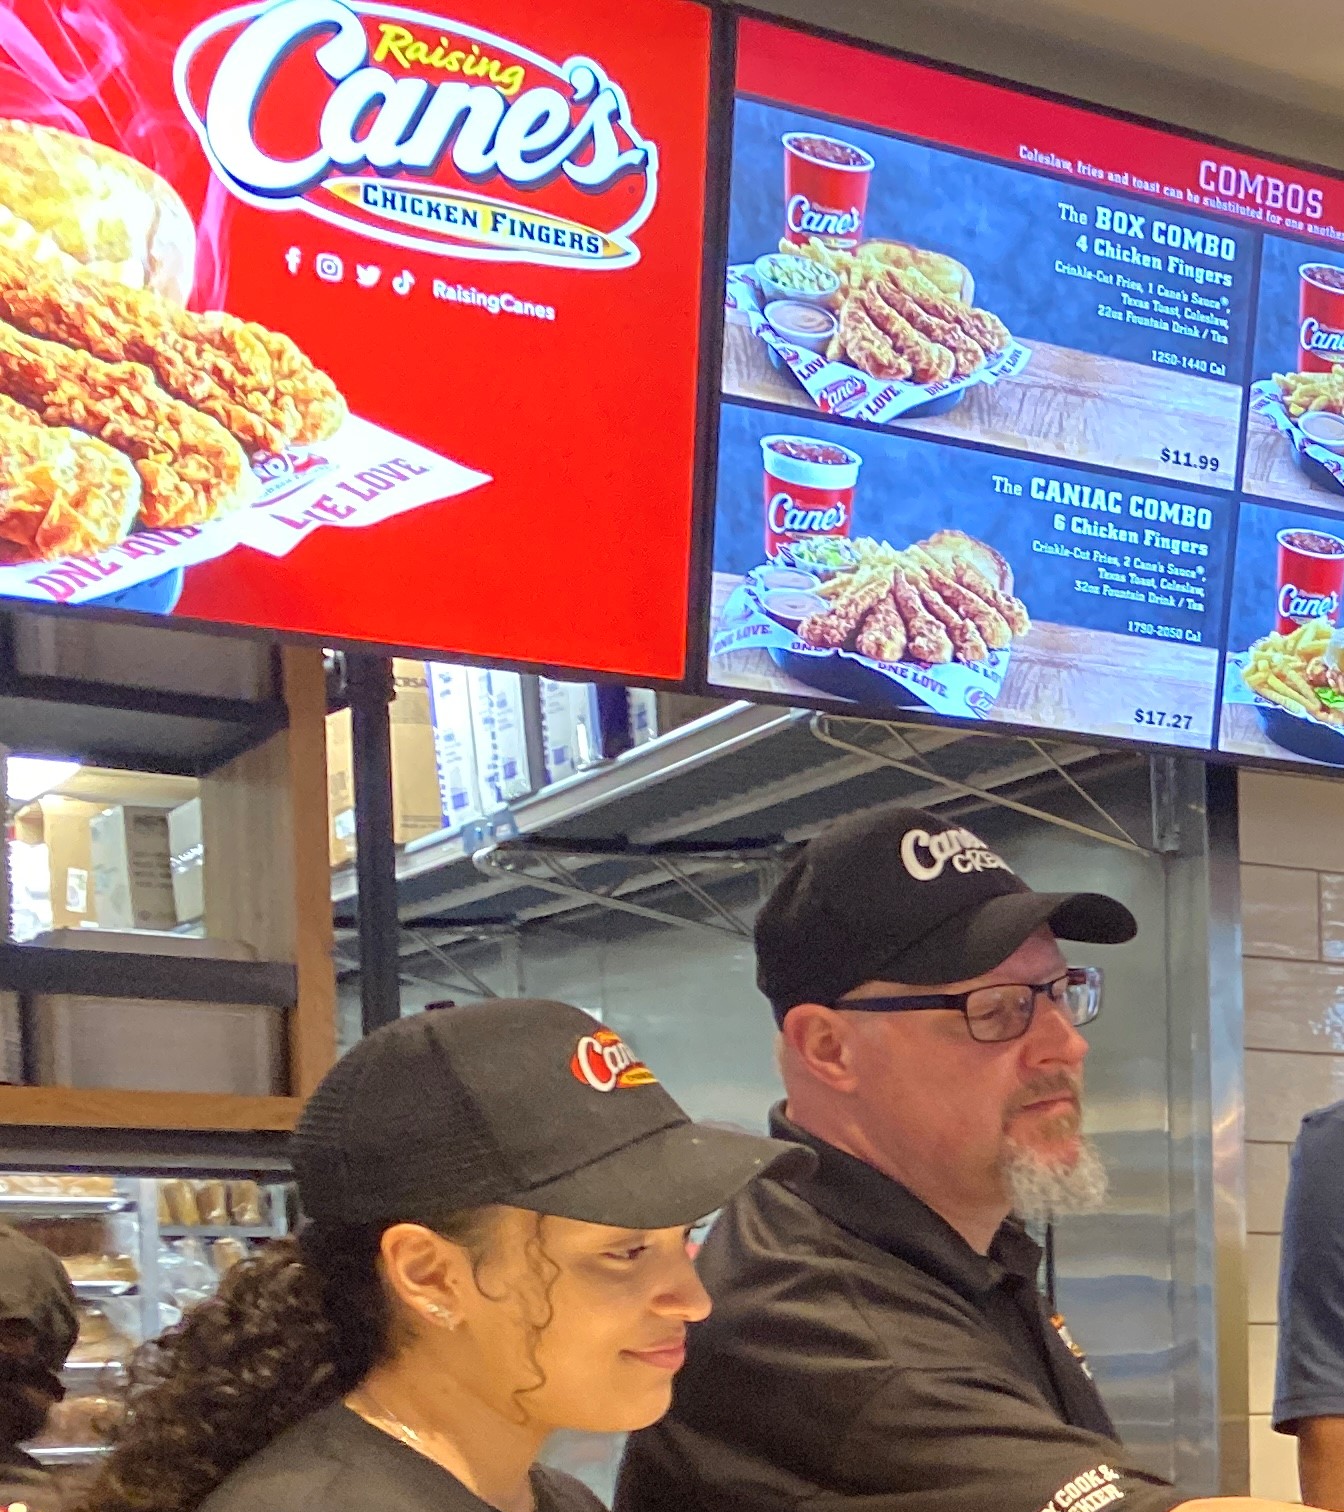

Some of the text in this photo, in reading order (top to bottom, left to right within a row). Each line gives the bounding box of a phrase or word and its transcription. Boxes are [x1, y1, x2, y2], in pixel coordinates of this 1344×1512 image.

[374, 23, 526, 95] Raising
[207, 0, 650, 195] Cane's
[1019, 145, 1073, 173] Coleslaw,
[1077, 161, 1104, 180] fries
[1107, 171, 1129, 186] and
[1132, 176, 1160, 194] toast
[1163, 186, 1183, 200] can
[1186, 188, 1200, 204] be
[1203, 195, 1262, 219] substituted
[1266, 209, 1283, 225] for
[1285, 217, 1304, 231] one
[1199, 160, 1324, 220] COMBOS
[1057, 202, 1236, 261] The BOX COMBO
[1054, 260, 1114, 286] Crinkle-Cut
[1116, 274, 1144, 294] Fries,
[1156, 284, 1188, 304] Cane's
[1076, 235, 1233, 287] 4 Chicken Fingers
[432, 278, 557, 323] RaisingCanes
[1160, 447, 1219, 473] $11.99
[769, 492, 847, 534] Cane's
[992, 475, 1213, 531] The CANIAC COMBO
[1032, 540, 1091, 562] Crinkle-Cut
[1053, 513, 1209, 557] 6 Chicken Fingers
[1134, 708, 1193, 731] $17.27
[1055, 1471, 1105, 1511] COOK
[1098, 1464, 1120, 1483] &
